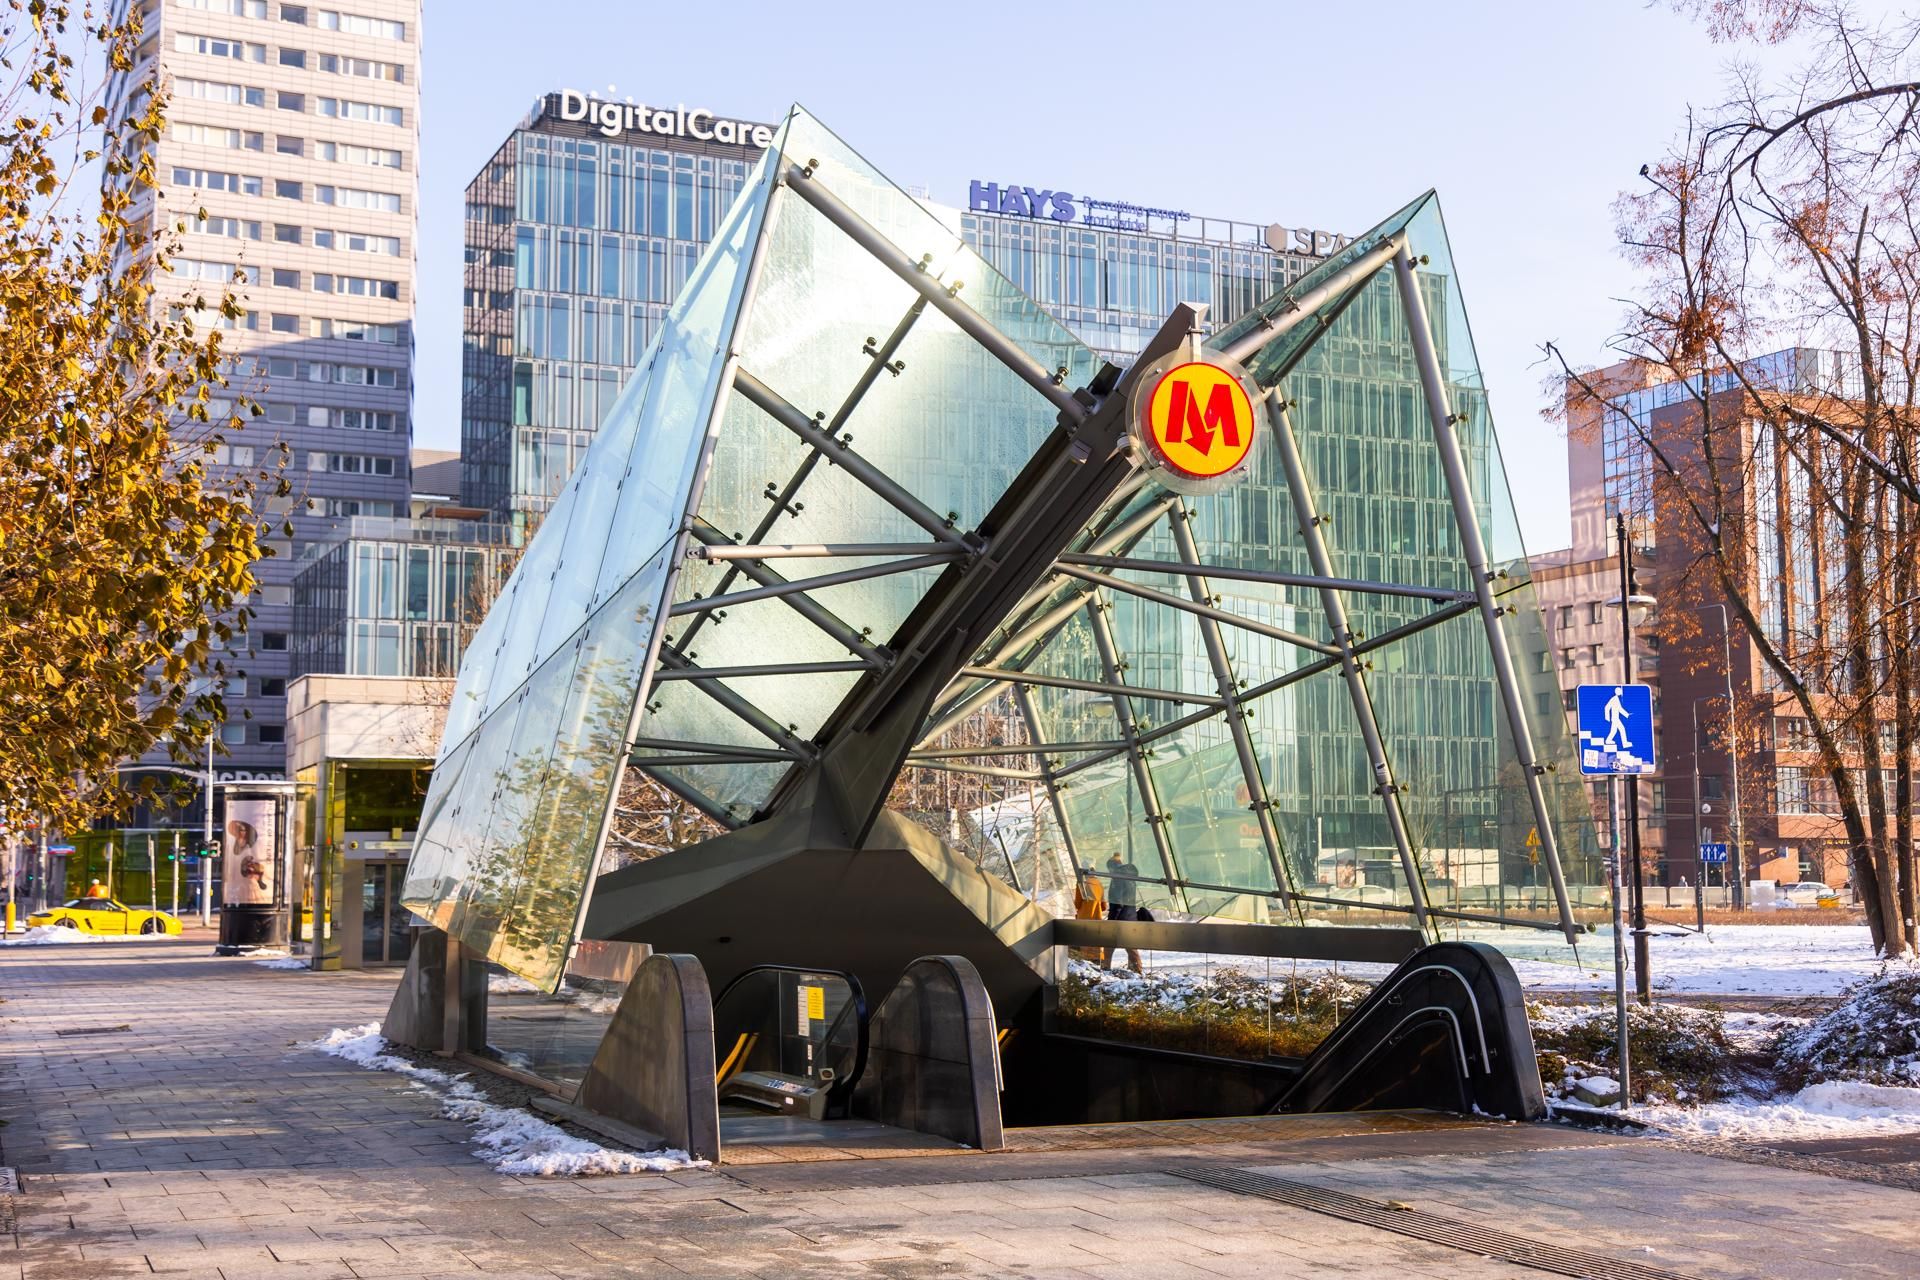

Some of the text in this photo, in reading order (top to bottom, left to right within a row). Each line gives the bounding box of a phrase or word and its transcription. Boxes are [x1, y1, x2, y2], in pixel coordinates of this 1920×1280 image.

[561, 87, 773, 149] DigitalCare
[970, 180, 1076, 222] HAYS
[1083, 196, 1191, 222] Recruiting experts
[1083, 214, 1146, 232] worldwide
[1295, 228, 1362, 258] SPA
[1165, 380, 1240, 457] M
